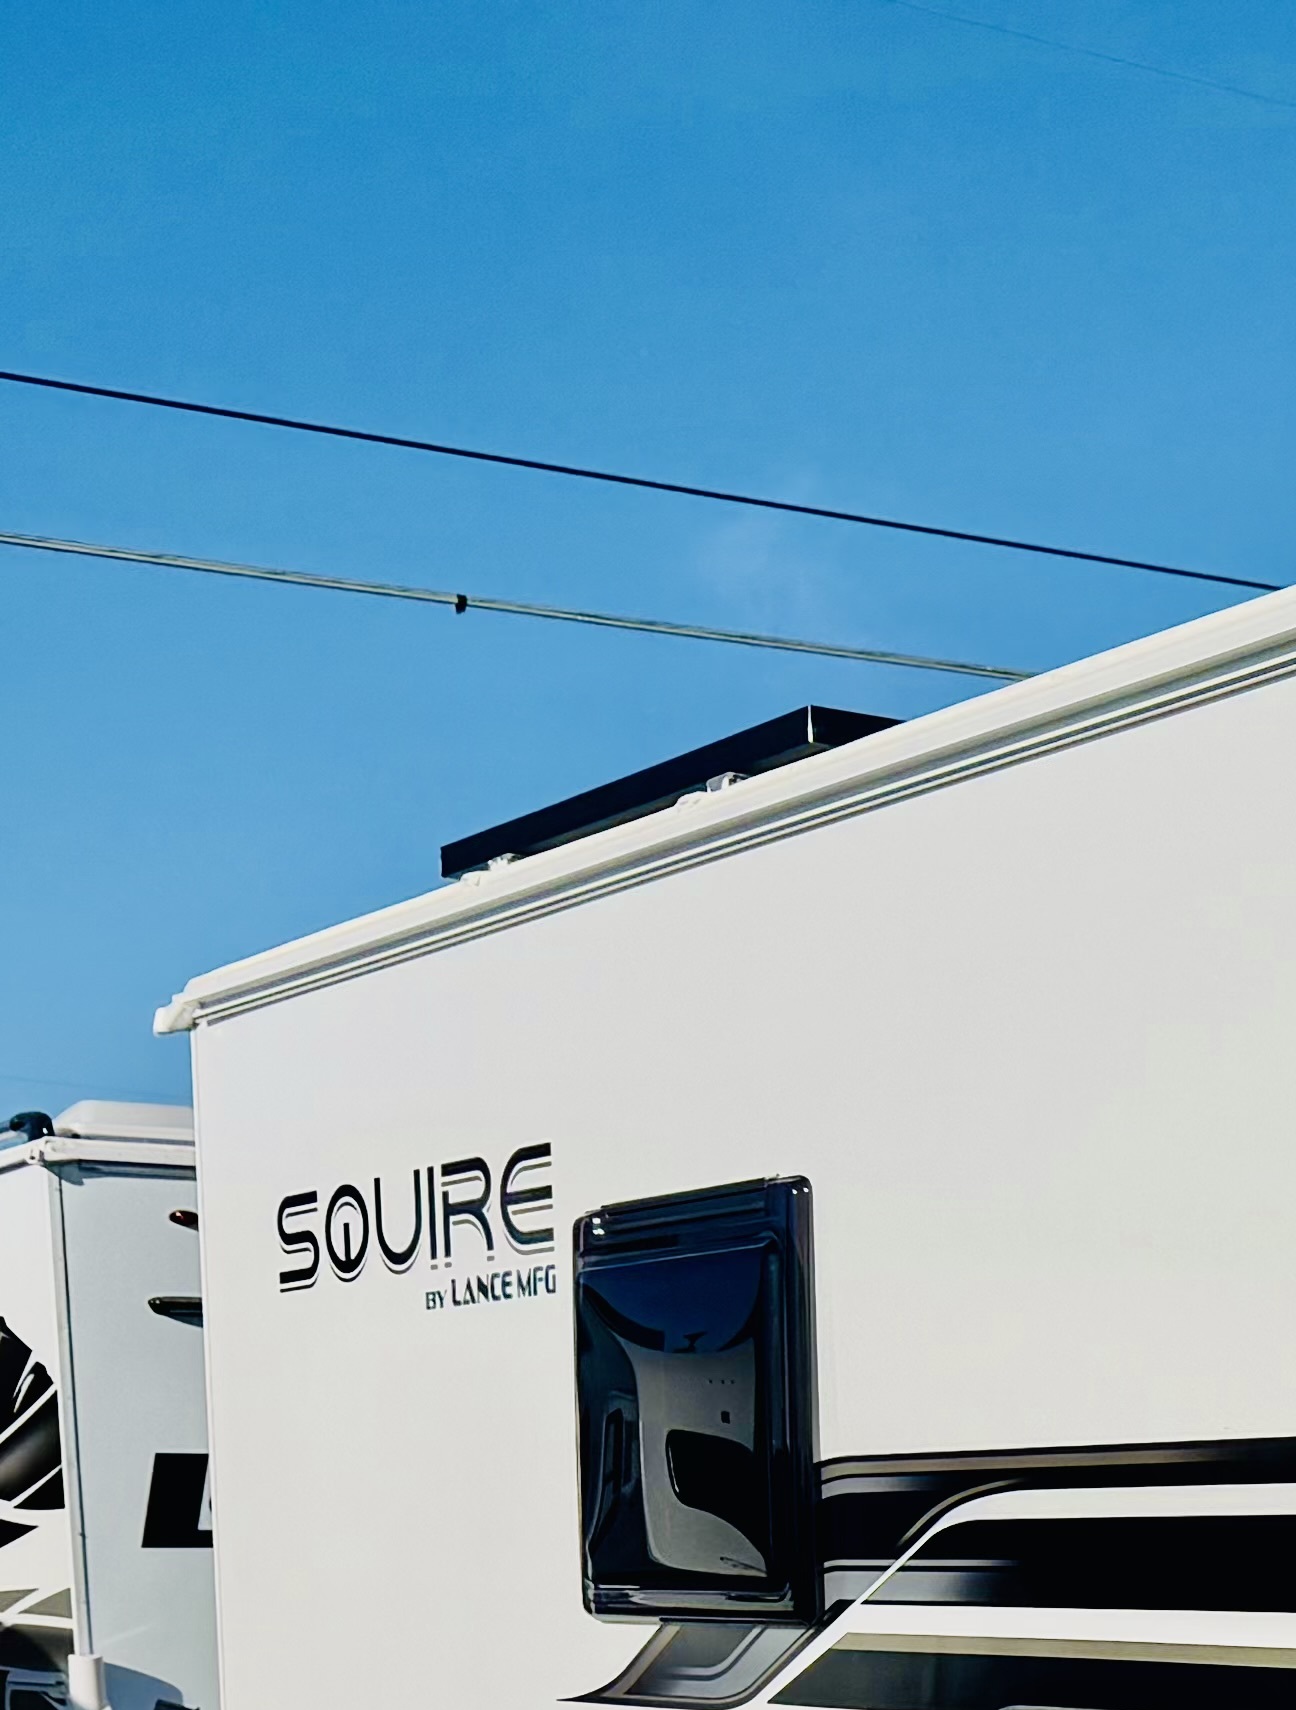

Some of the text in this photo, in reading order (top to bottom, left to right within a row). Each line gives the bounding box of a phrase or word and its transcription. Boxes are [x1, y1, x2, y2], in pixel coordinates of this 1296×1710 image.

[277, 1141, 555, 1294] SQUIRE
[425, 1264, 556, 1311] BY LANCE MFG
